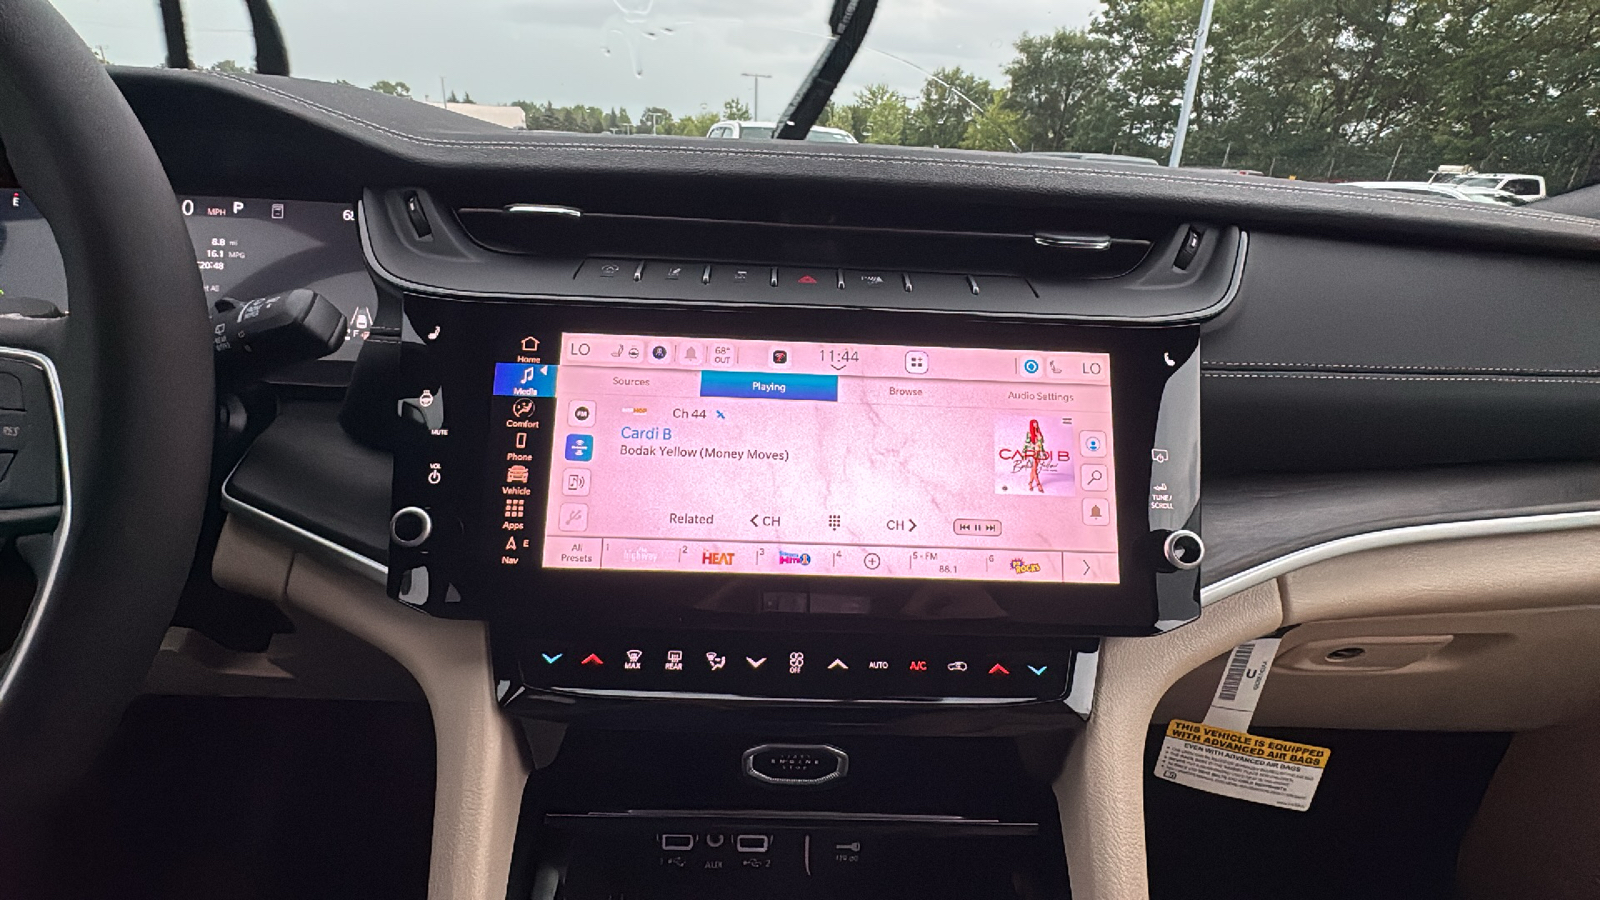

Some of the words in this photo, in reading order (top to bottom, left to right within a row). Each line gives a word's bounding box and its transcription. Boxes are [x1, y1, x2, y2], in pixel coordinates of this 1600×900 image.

[12, 197, 20, 206] E
[182, 199, 194, 216] 0
[207, 208, 226, 216] MPH
[233, 201, 244, 214] P
[211, 238, 226, 246] 8.8
[207, 250, 224, 258] 16.1
[571, 343, 590, 356] LO
[517, 355, 540, 363] Home
[715, 356, 730, 364] OUT
[820, 350, 860, 362] 11:44
[1082, 362, 1101, 375] LO
[612, 376, 650, 386] Sources
[513, 387, 538, 396] Media
[752, 382, 786, 393] Playing
[889, 386, 923, 396] Browse
[1008, 391, 1035, 400] Audio
[1037, 392, 1074, 403] Settings
[672, 408, 688, 418] Ch
[691, 409, 707, 419] 44
[506, 420, 539, 428] Comfort
[2, 426, 20, 437] RES
[621, 426, 659, 440] Cardi
[663, 428, 672, 440] B
[507, 452, 533, 461] Phone
[620, 445, 656, 456] Bodak
[659, 446, 697, 458] Yellow
[700, 448, 744, 460] (Money
[747, 449, 789, 462] Moves)
[999, 448, 1052, 460] CARDI
[1058, 451, 1070, 461] B
[502, 486, 531, 496] Vehicle
[669, 513, 714, 524] Related
[762, 516, 781, 527] CH
[502, 521, 524, 530] Apps
[886, 520, 905, 531] CH
[523, 539, 530, 548] E
[682, 546, 688, 554] 2
[502, 556, 519, 564] Nav
[561, 554, 592, 562] Presets
[702, 552, 735, 565] HEAT
[939, 565, 958, 573] 88.1
[624, 661, 641, 670] MAX
[665, 662, 682, 670] REAR
[789, 666, 801, 674] OFF
[909, 661, 927, 671] A/C
[1176, 722, 1200, 733] THIS
[1204, 728, 1252, 745] VEHICLE
[1268, 742, 1324, 757] EQUIPPED
[1172, 730, 1201, 741] WITH
[1203, 737, 1265, 755] ADVANCED
[1267, 751, 1287, 760] AIR
[1289, 754, 1320, 766] BAGS
[1184, 742, 1203, 752] EVEN
[1205, 747, 1223, 757] WITH
[1224, 752, 1266, 765] ADVANCED
[1280, 764, 1300, 772] BAGS
